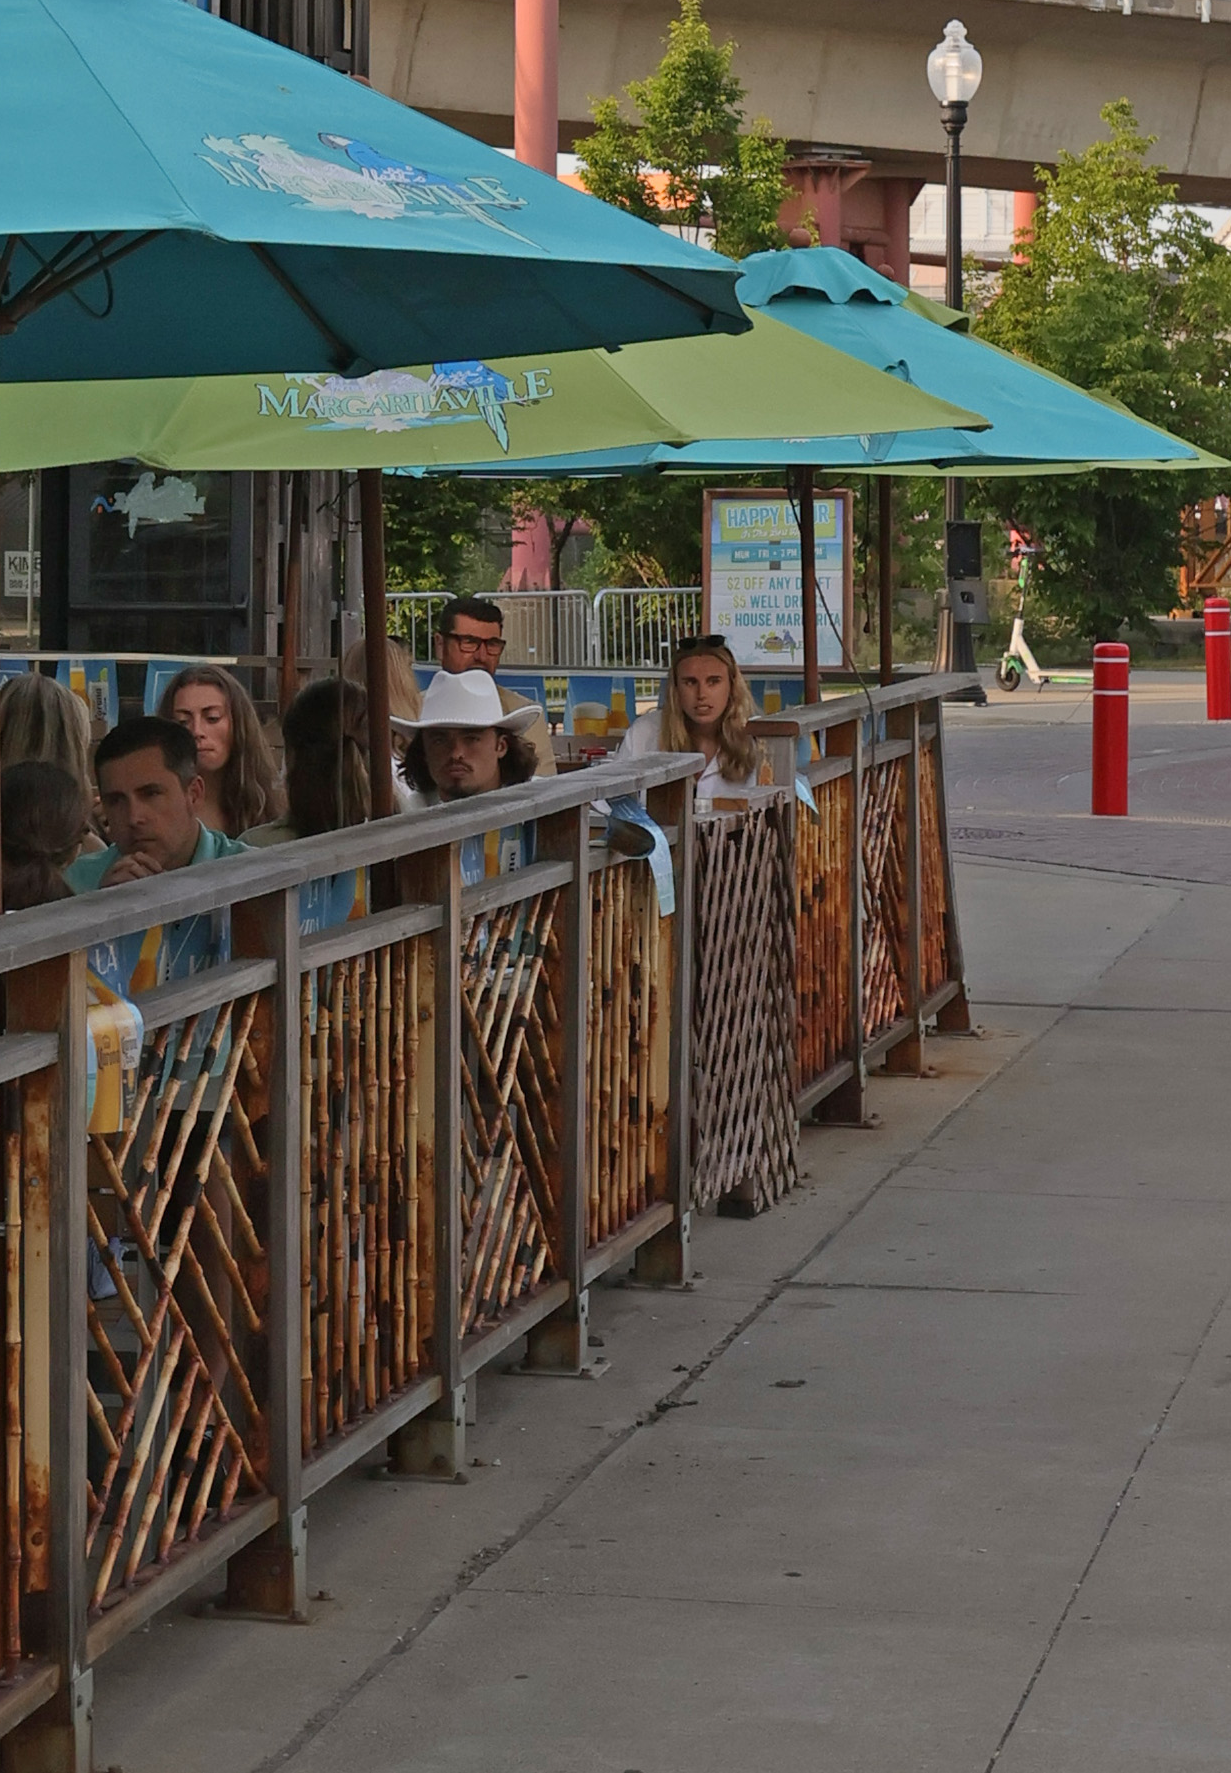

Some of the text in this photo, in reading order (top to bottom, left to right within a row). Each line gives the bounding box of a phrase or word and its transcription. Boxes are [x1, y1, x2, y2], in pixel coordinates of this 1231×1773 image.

[255, 367, 554, 419] MARGARITAVILLE
[727, 503, 830, 528] HAPPY HR
[727, 577, 831, 590] $2 OFF ANY DFT
[733, 595, 746, 608] $5
[750, 595, 780, 608] WELL
[718, 613, 841, 626] $5 HOUSE MARRITA
